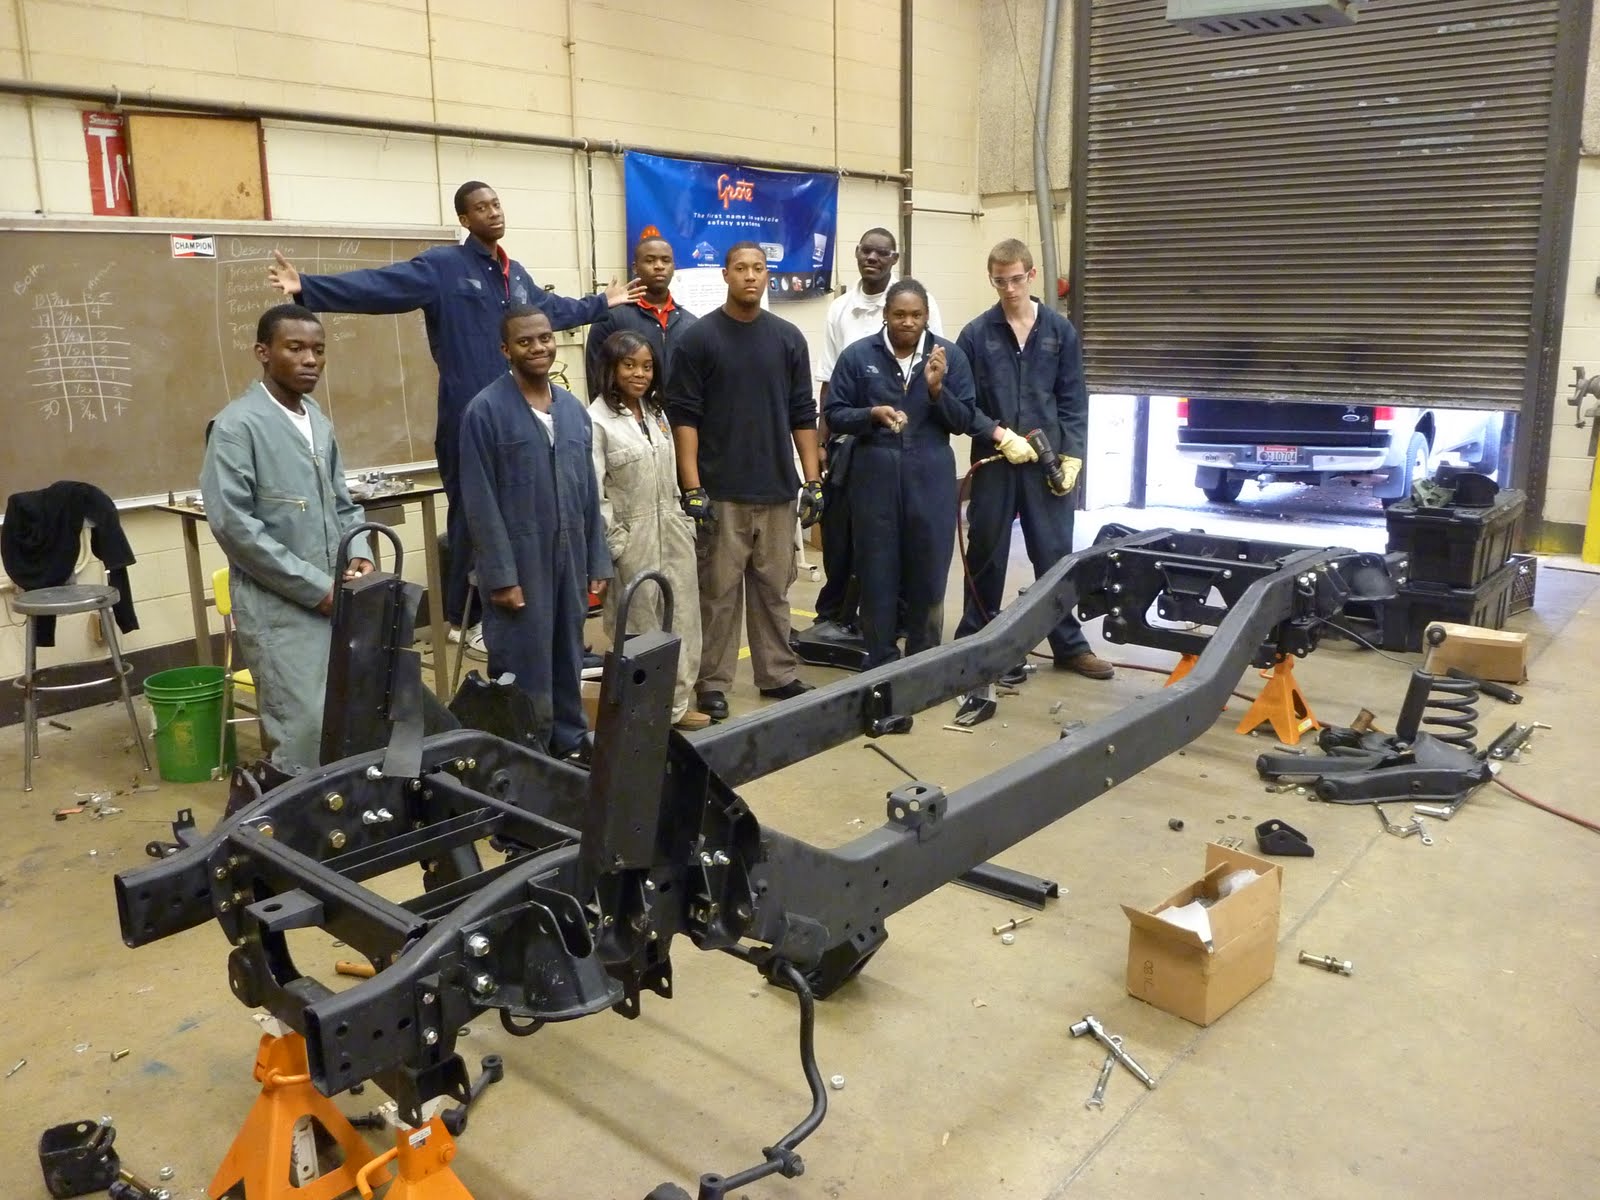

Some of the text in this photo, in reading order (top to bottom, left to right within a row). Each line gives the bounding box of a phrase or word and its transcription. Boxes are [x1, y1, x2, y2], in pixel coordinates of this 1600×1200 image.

[717, 174, 755, 211] Grote
[707, 219, 734, 227] safety
[174, 241, 213, 250] CHAMPION
